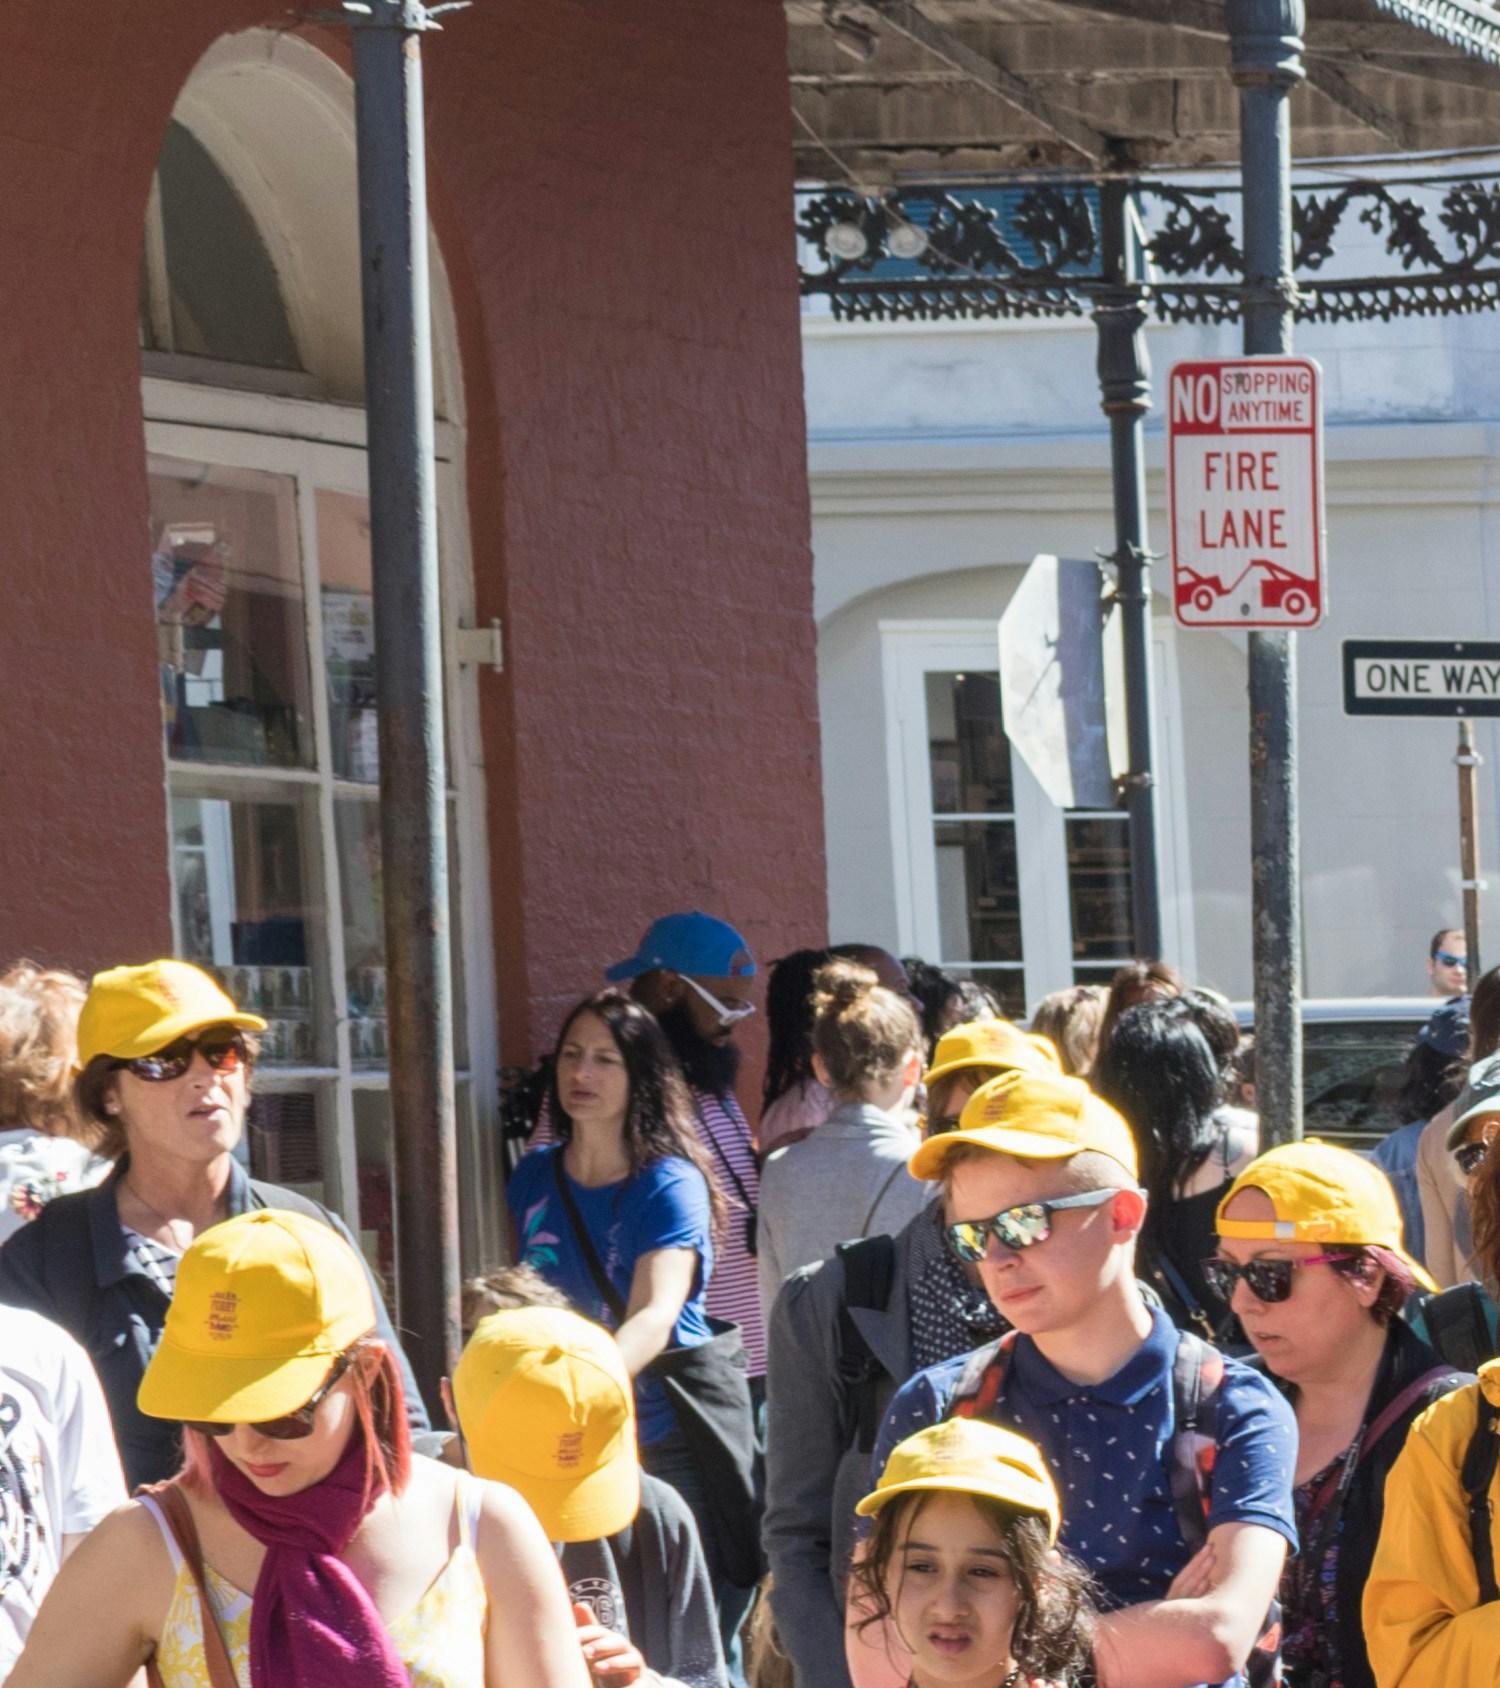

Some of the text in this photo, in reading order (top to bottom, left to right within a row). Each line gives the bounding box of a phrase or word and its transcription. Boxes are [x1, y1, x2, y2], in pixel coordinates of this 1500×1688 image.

[1173, 374, 1219, 424] NO
[1223, 373, 1311, 394] STOPPING
[1228, 400, 1304, 422] ANYTIME
[1205, 452, 1280, 491] FIRE
[1200, 509, 1288, 549] LANE
[1366, 664, 1431, 693] ONE
